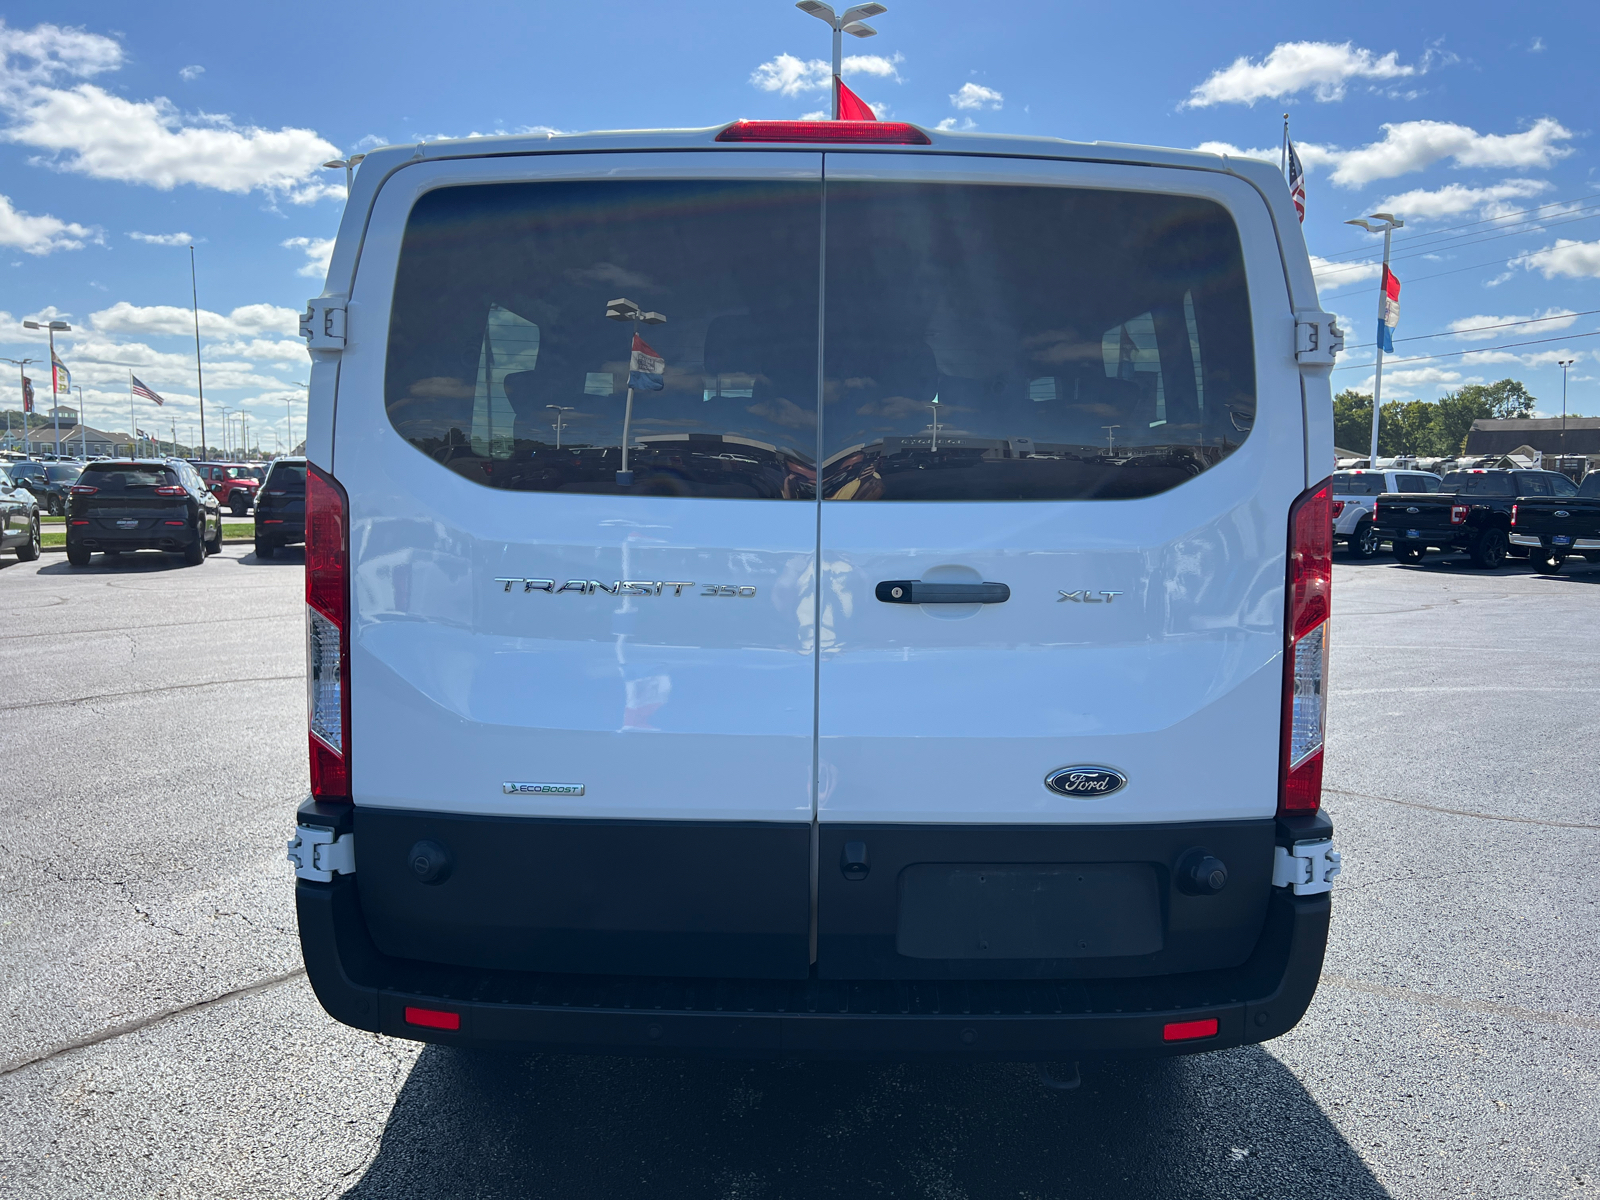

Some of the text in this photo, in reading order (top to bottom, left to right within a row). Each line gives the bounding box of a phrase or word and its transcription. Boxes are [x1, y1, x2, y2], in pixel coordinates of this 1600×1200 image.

[494, 577, 756, 598] TRANSIT 350
[1057, 590, 1124, 603] XLT
[1065, 772, 1109, 791] Ford
